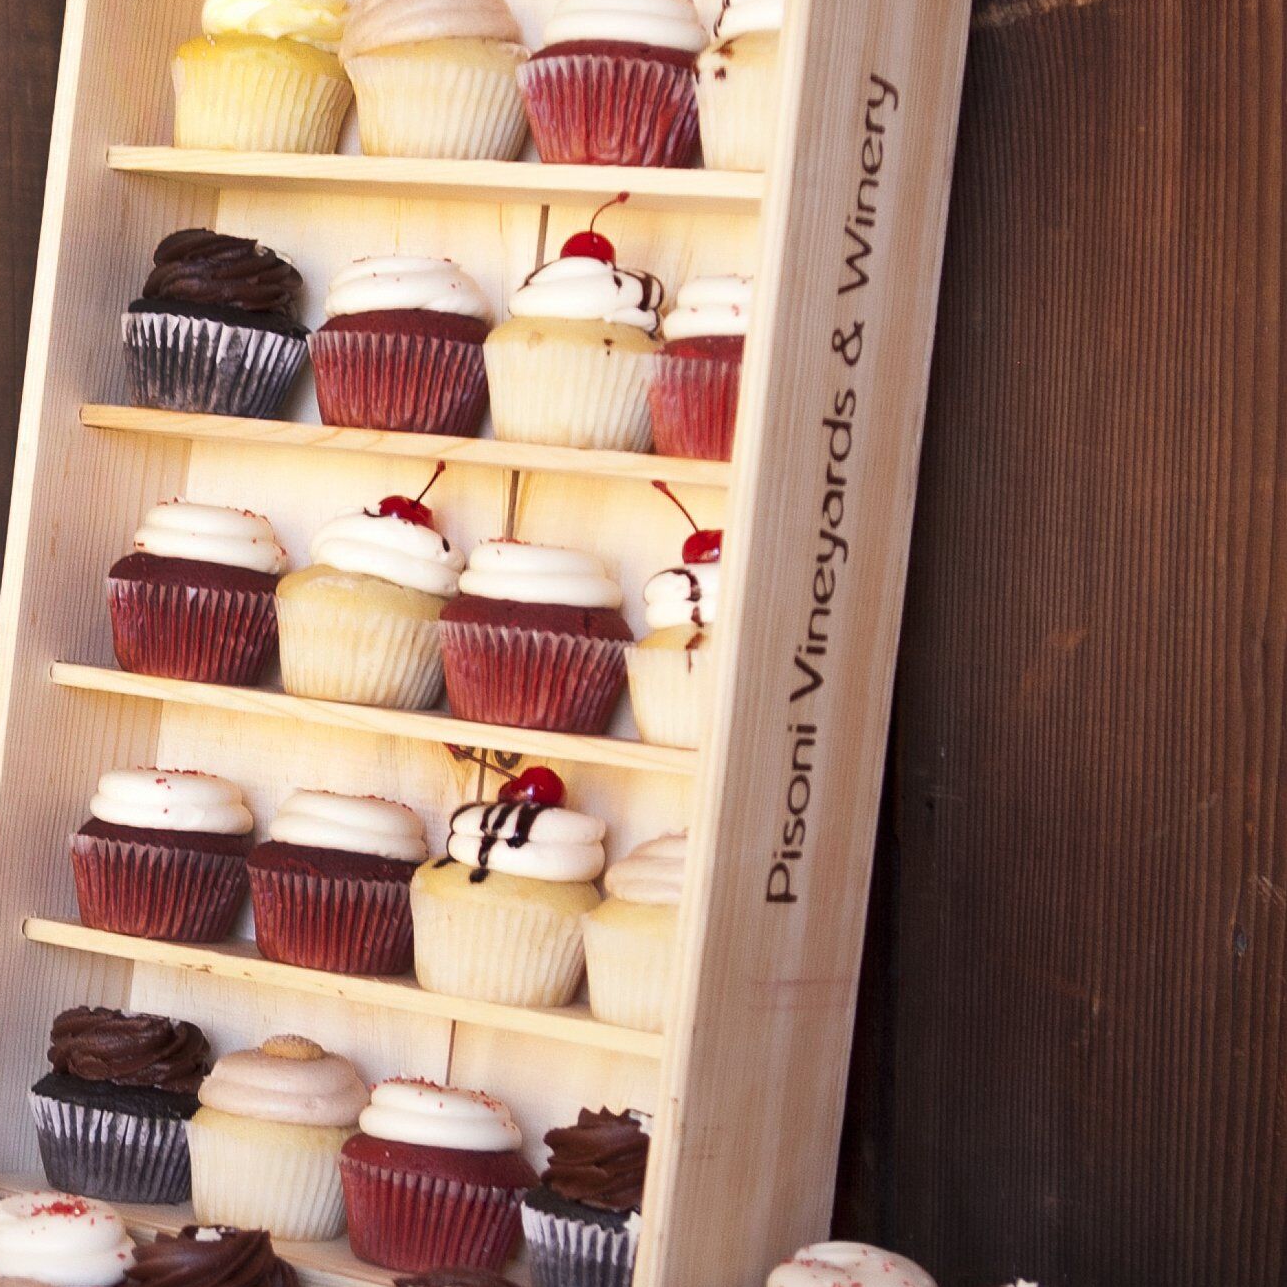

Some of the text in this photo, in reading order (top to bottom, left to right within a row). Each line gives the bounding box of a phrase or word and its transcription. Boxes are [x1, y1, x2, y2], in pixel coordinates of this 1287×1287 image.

[766, 72, 899, 905] Pisoni Vineyards & Winery
